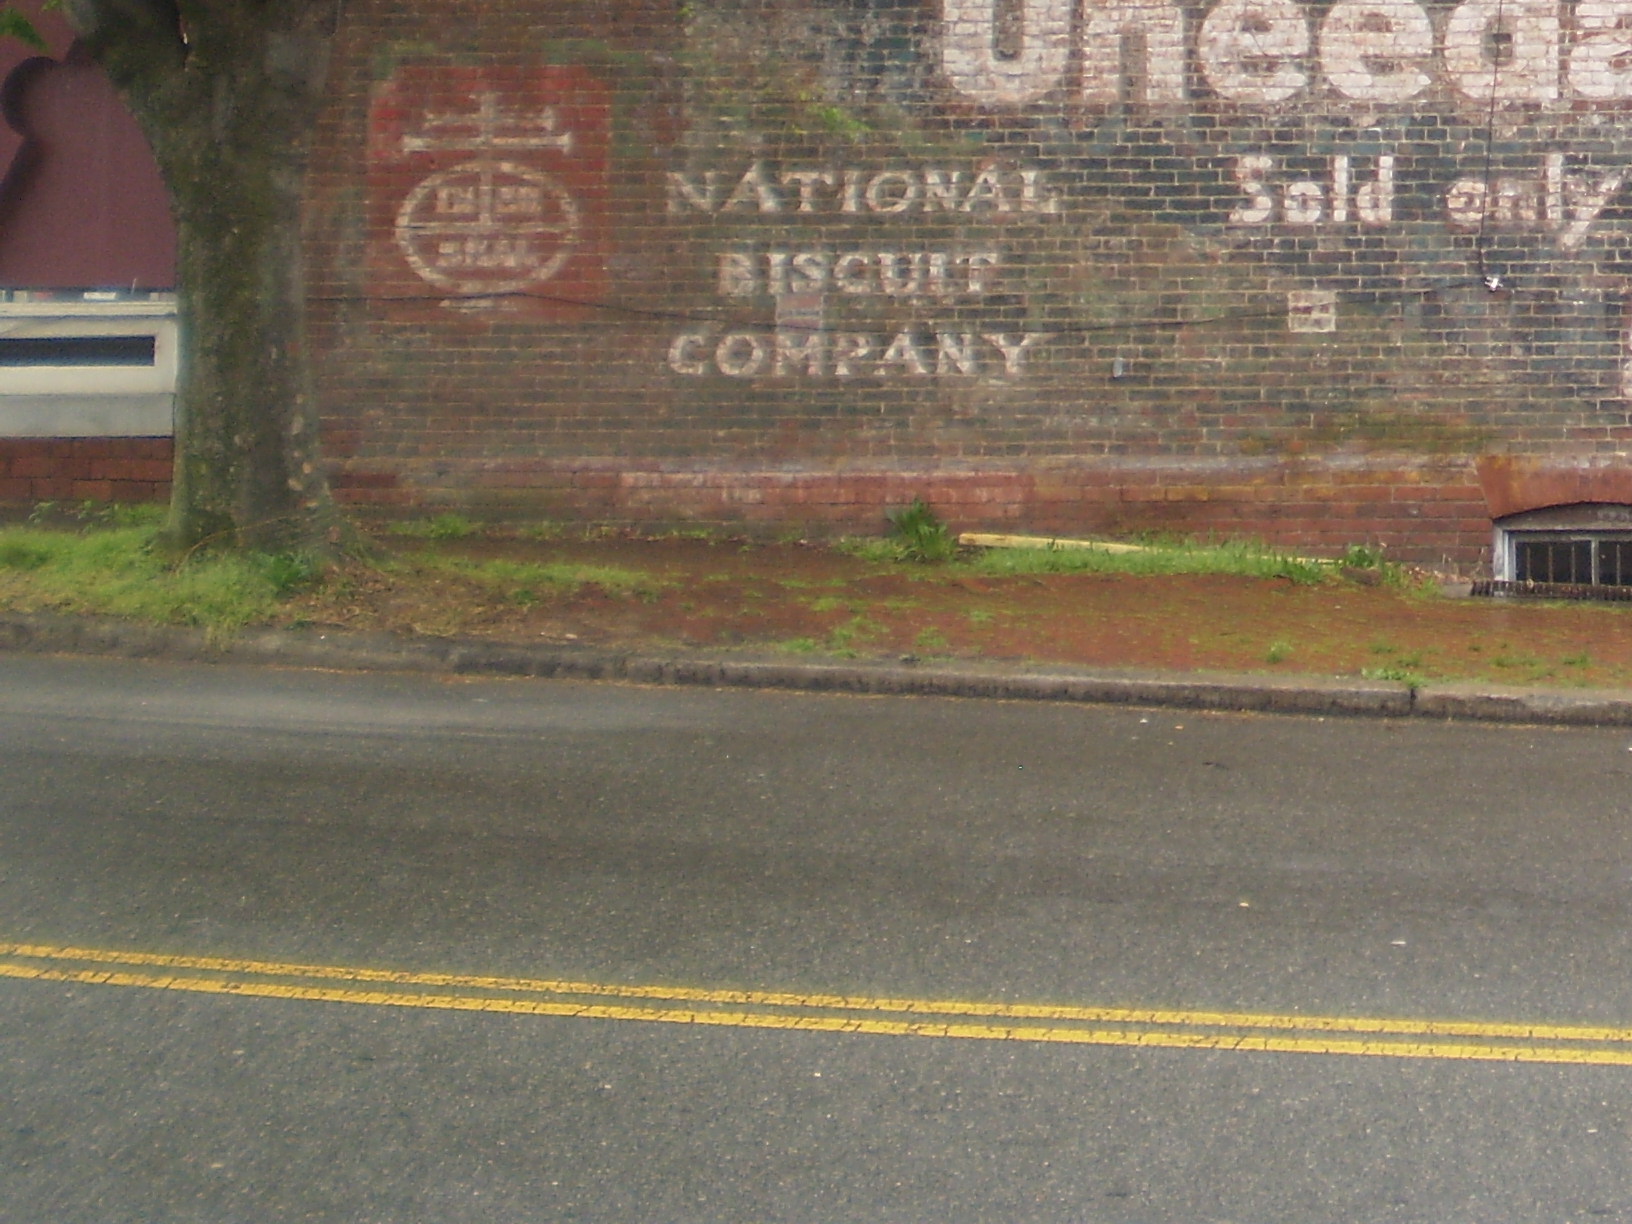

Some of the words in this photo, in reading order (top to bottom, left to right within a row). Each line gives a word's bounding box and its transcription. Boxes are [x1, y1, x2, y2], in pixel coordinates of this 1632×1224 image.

[664, 161, 1059, 216] NATIONAL
[1230, 154, 1395, 226] Sold
[1446, 152, 1627, 252] only
[719, 252, 999, 296] BISCUIT
[667, 330, 1040, 377] COMPANY
